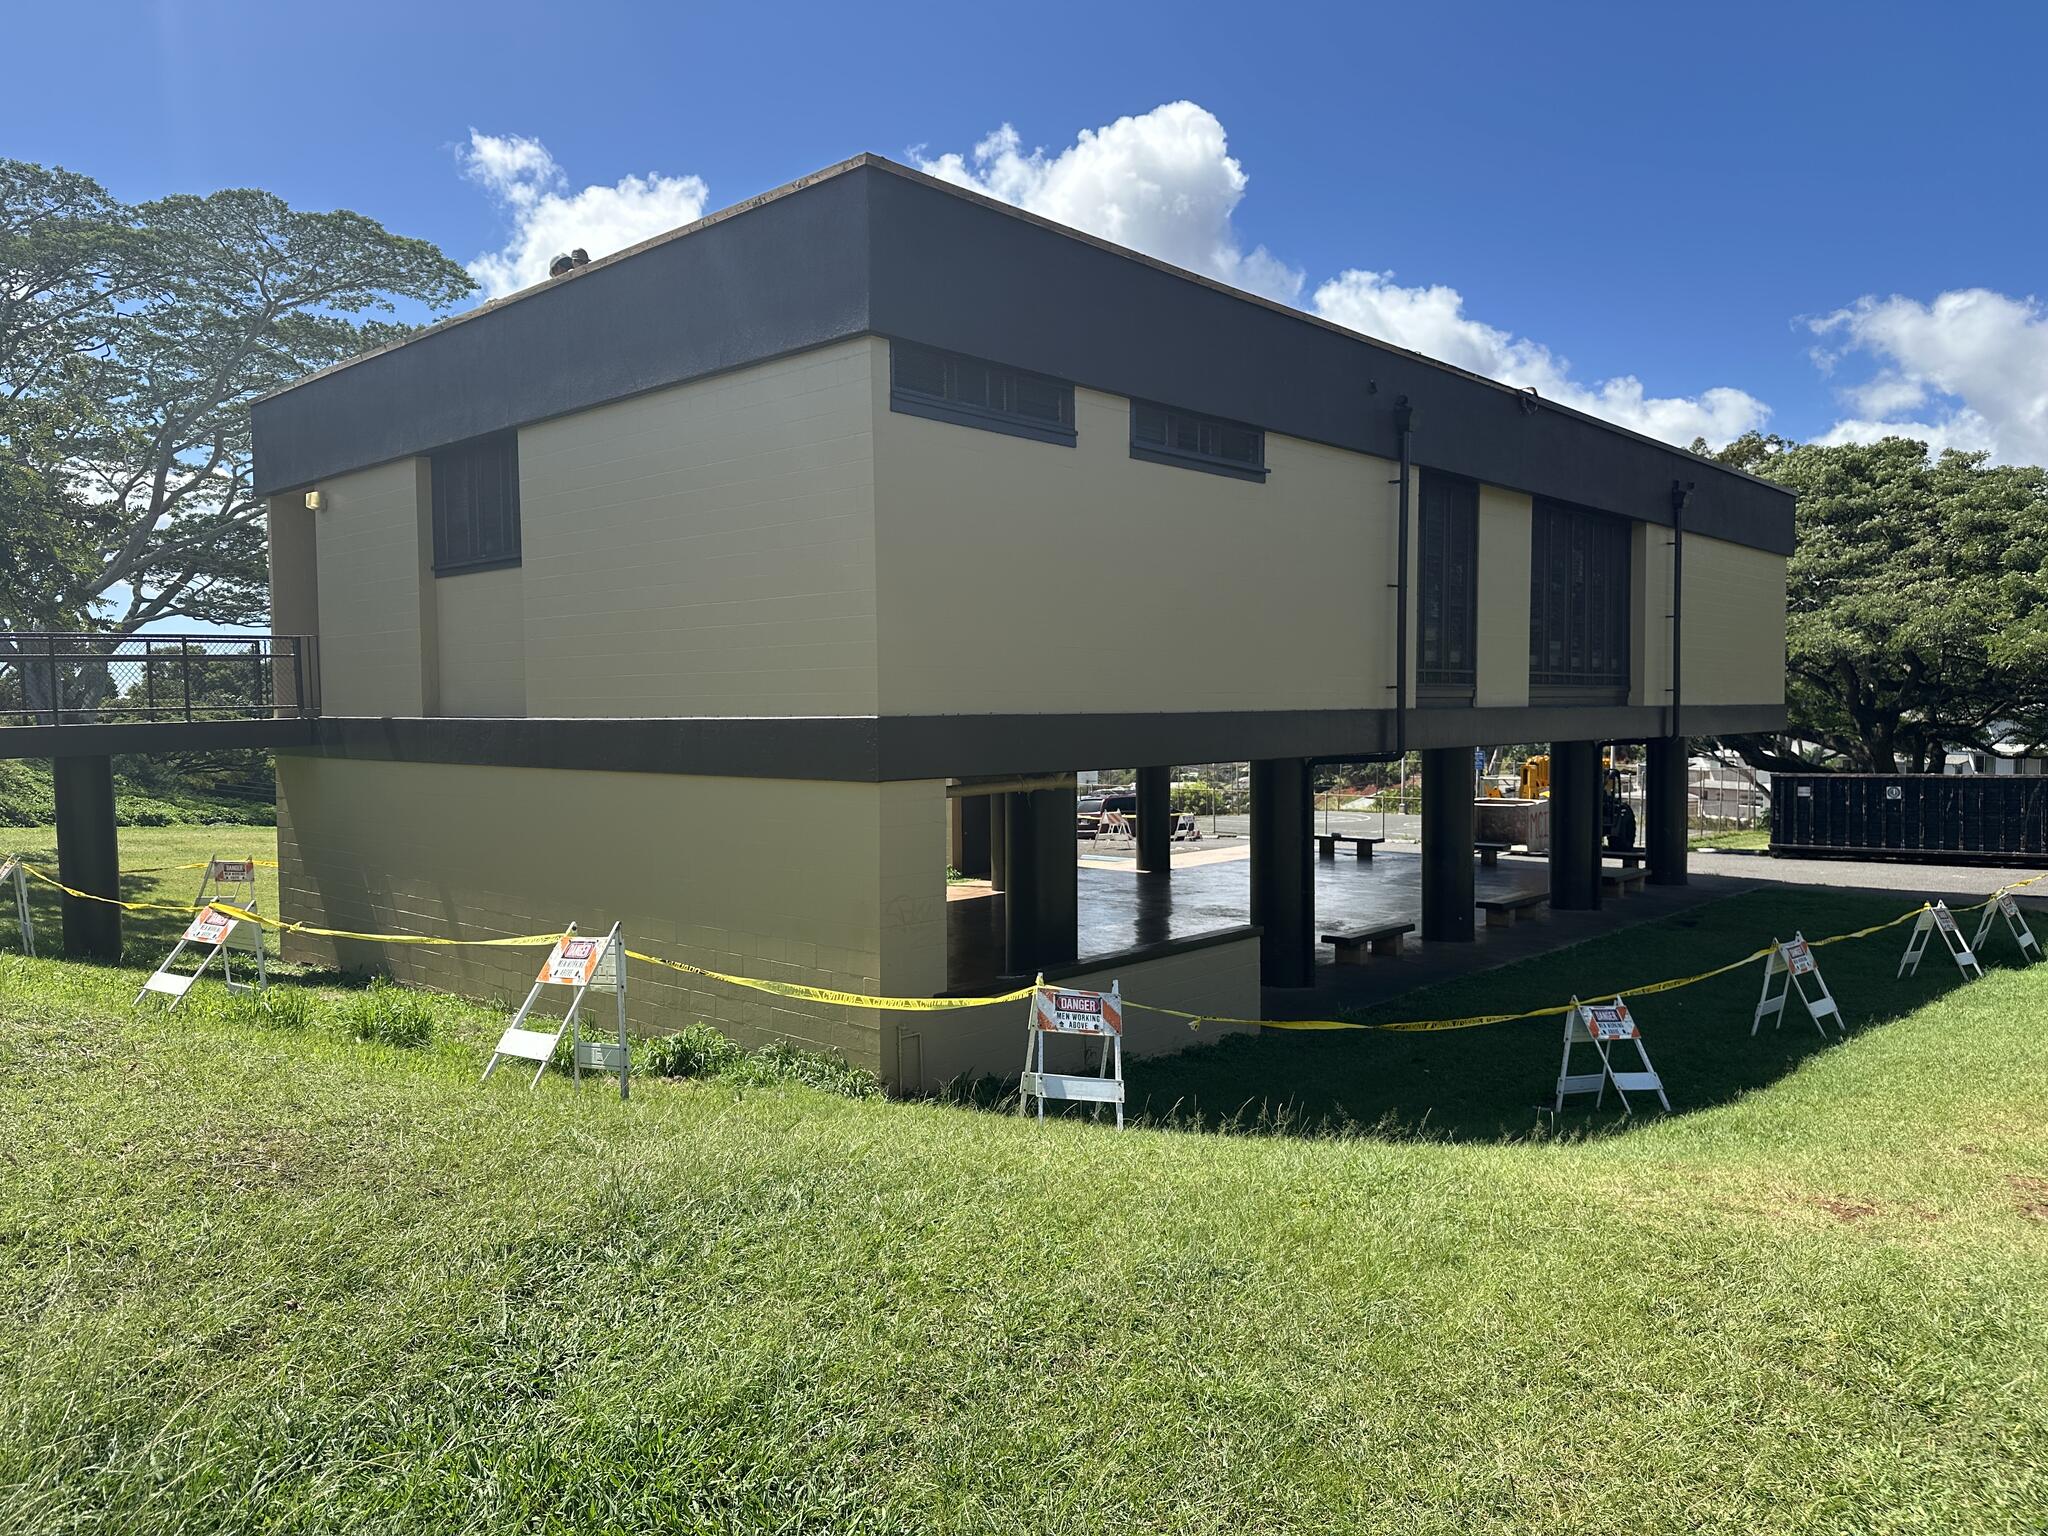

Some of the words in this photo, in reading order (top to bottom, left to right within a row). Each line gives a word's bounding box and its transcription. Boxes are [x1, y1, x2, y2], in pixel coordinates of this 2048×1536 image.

[1060, 997, 1097, 1013] DANGER
[1056, 1011, 1070, 1020] MEN
[1072, 1013, 1101, 1023] WORKING
[1068, 1021, 1089, 1030] ABOVE
